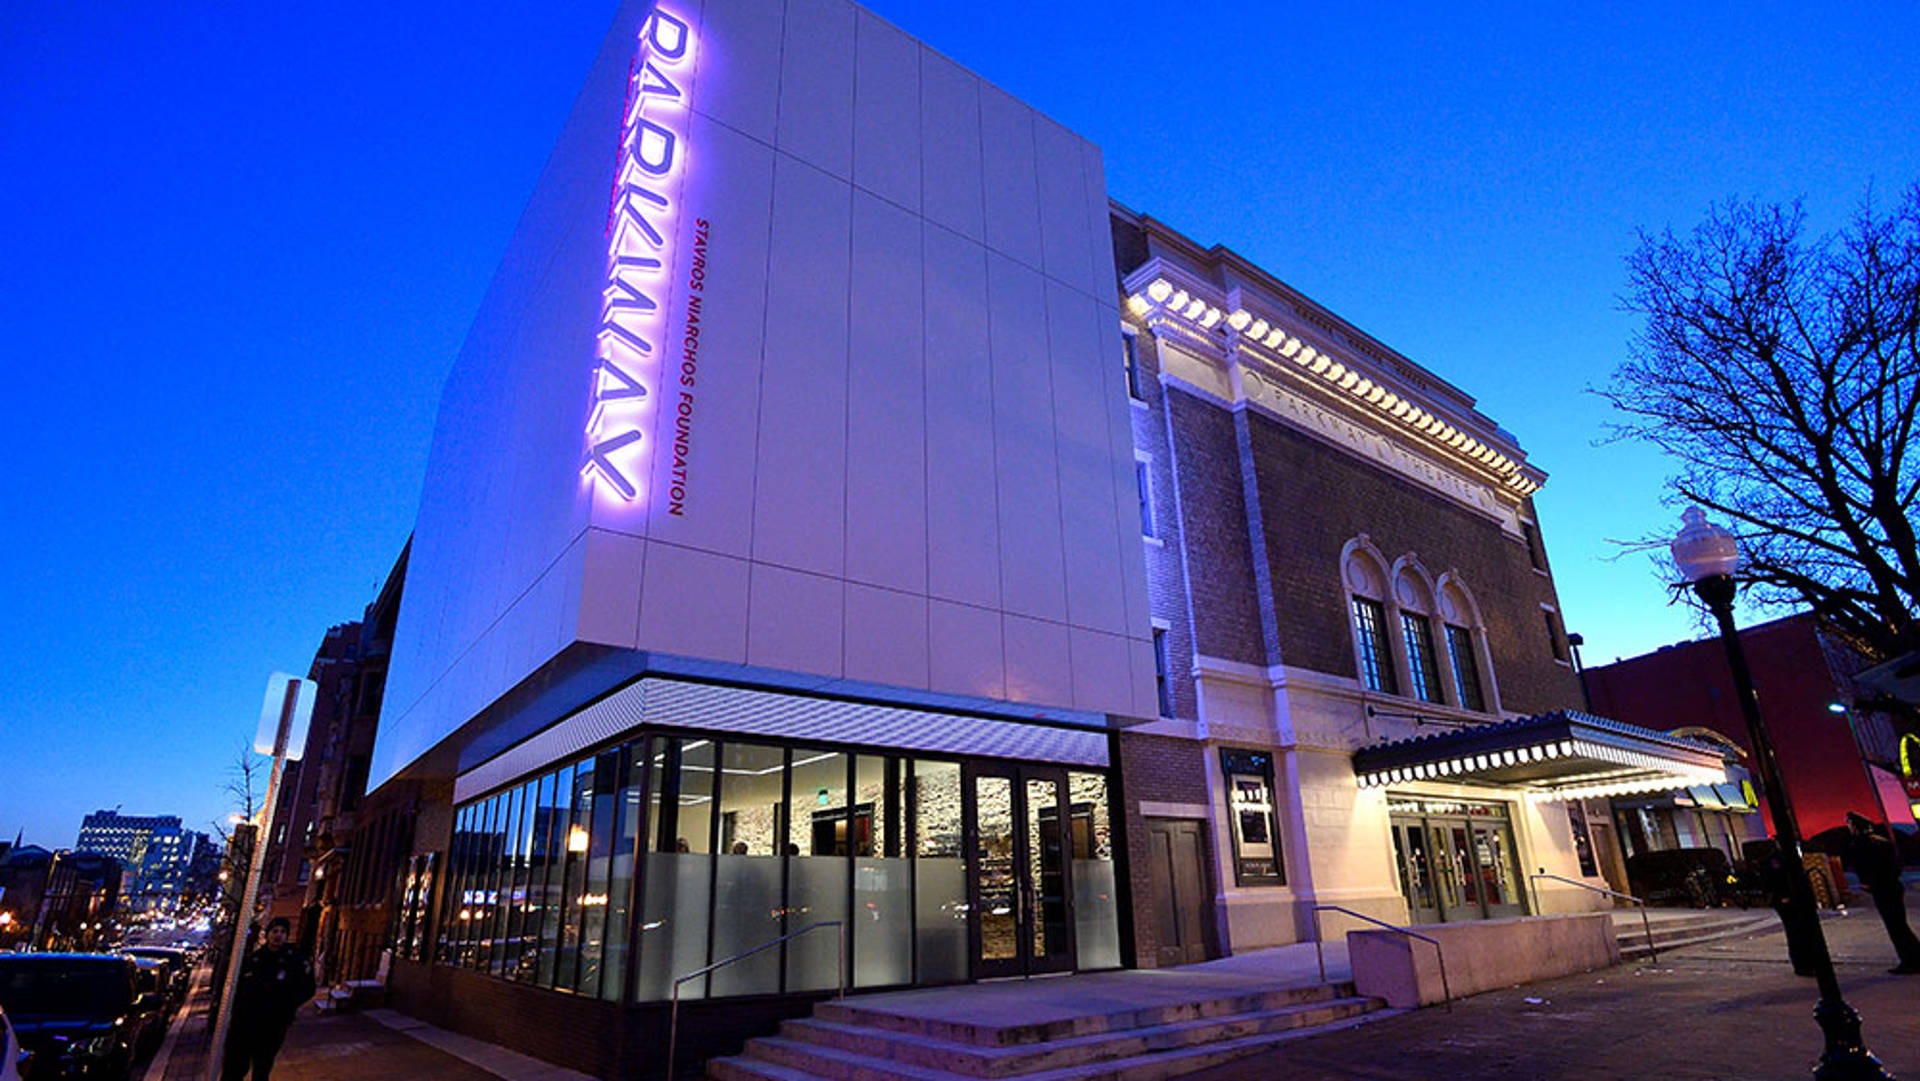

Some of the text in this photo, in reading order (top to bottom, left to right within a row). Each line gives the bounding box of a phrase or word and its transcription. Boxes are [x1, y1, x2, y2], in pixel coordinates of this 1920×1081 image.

[581, 5, 689, 503] PARKWAY
[668, 217, 710, 518] STAVROS NIARCHOS FOUNDATION
